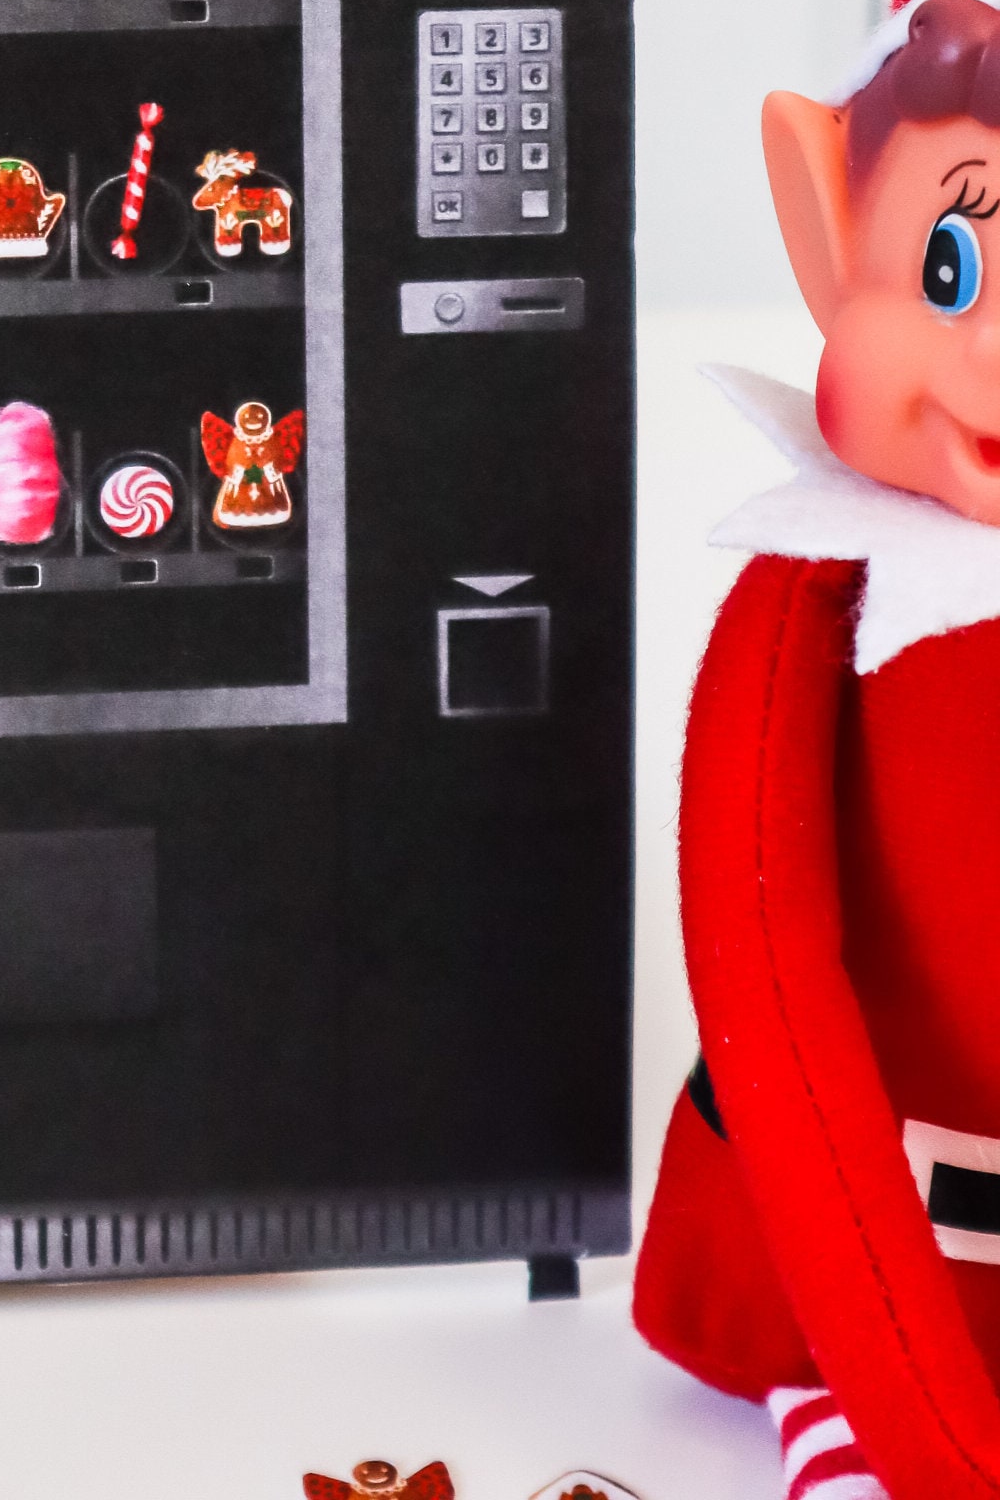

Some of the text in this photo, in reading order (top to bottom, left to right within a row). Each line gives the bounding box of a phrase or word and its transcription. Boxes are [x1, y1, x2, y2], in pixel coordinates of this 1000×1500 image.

[440, 28, 542, 48] 1 2 3
[441, 67, 542, 87] 4 5 6
[441, 108, 542, 127] 7 8 9
[485, 149, 498, 166] 0
